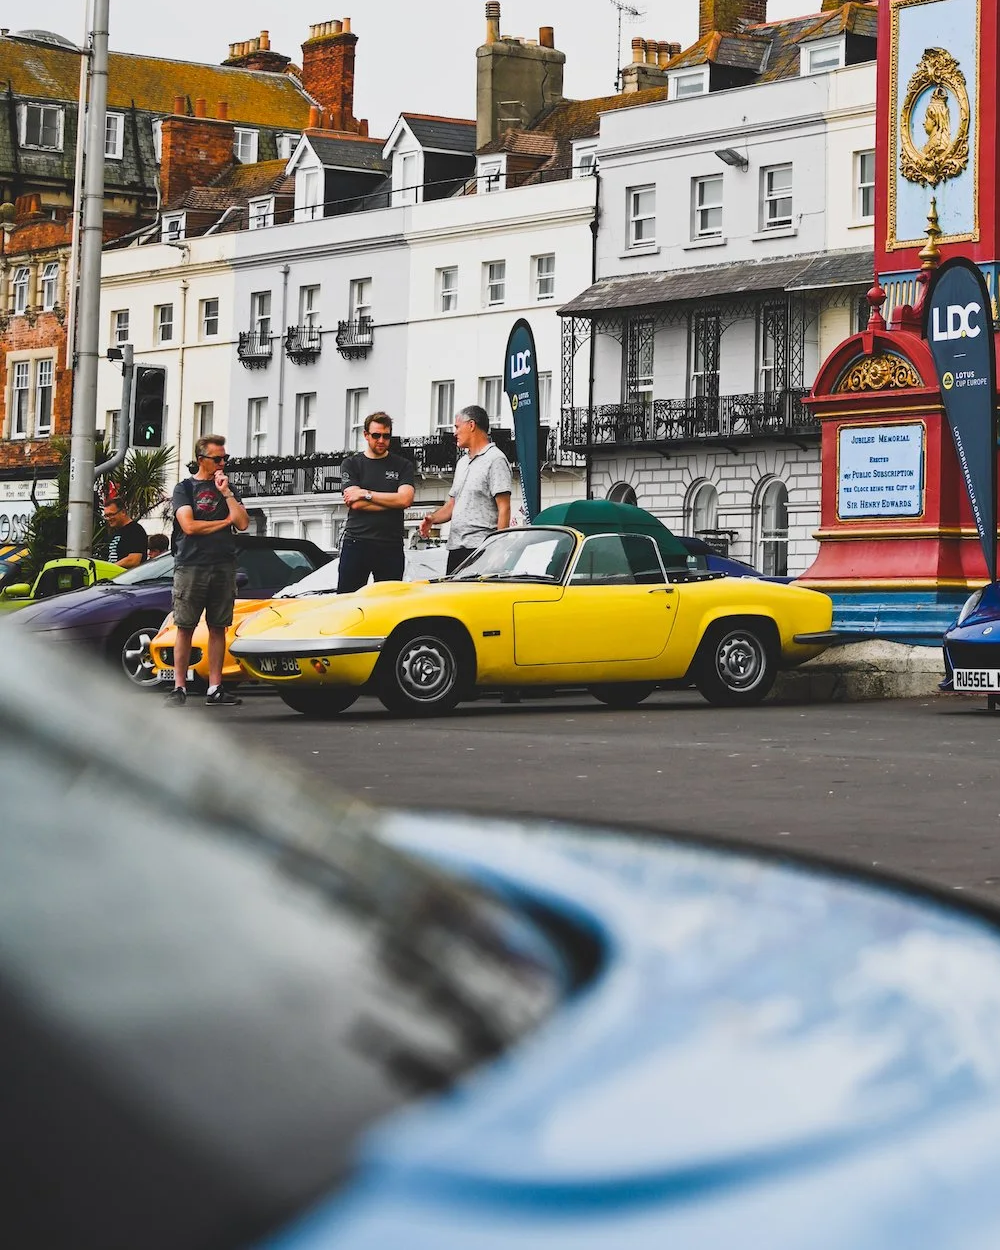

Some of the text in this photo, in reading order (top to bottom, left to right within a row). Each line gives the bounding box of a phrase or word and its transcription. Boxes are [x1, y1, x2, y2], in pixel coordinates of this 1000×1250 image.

[933, 302, 981, 341] LDC
[511, 349, 531, 379] LDC
[956, 371, 975, 379] LOTUS
[955, 379, 965, 387] CUP
[967, 378, 987, 387] EUROPE
[851, 434, 910, 444] JUBILEE MEMORIAL
[852, 470, 871, 479] PUBLIC
[873, 469, 914, 478] SUBSCRIPTION
[953, 426, 985, 537] LOTUSDRIVERSCLUB.ORG.UK
[846, 499, 912, 509] SIR HENRY EDWARDS
[259, 657, 277, 671] XMP
